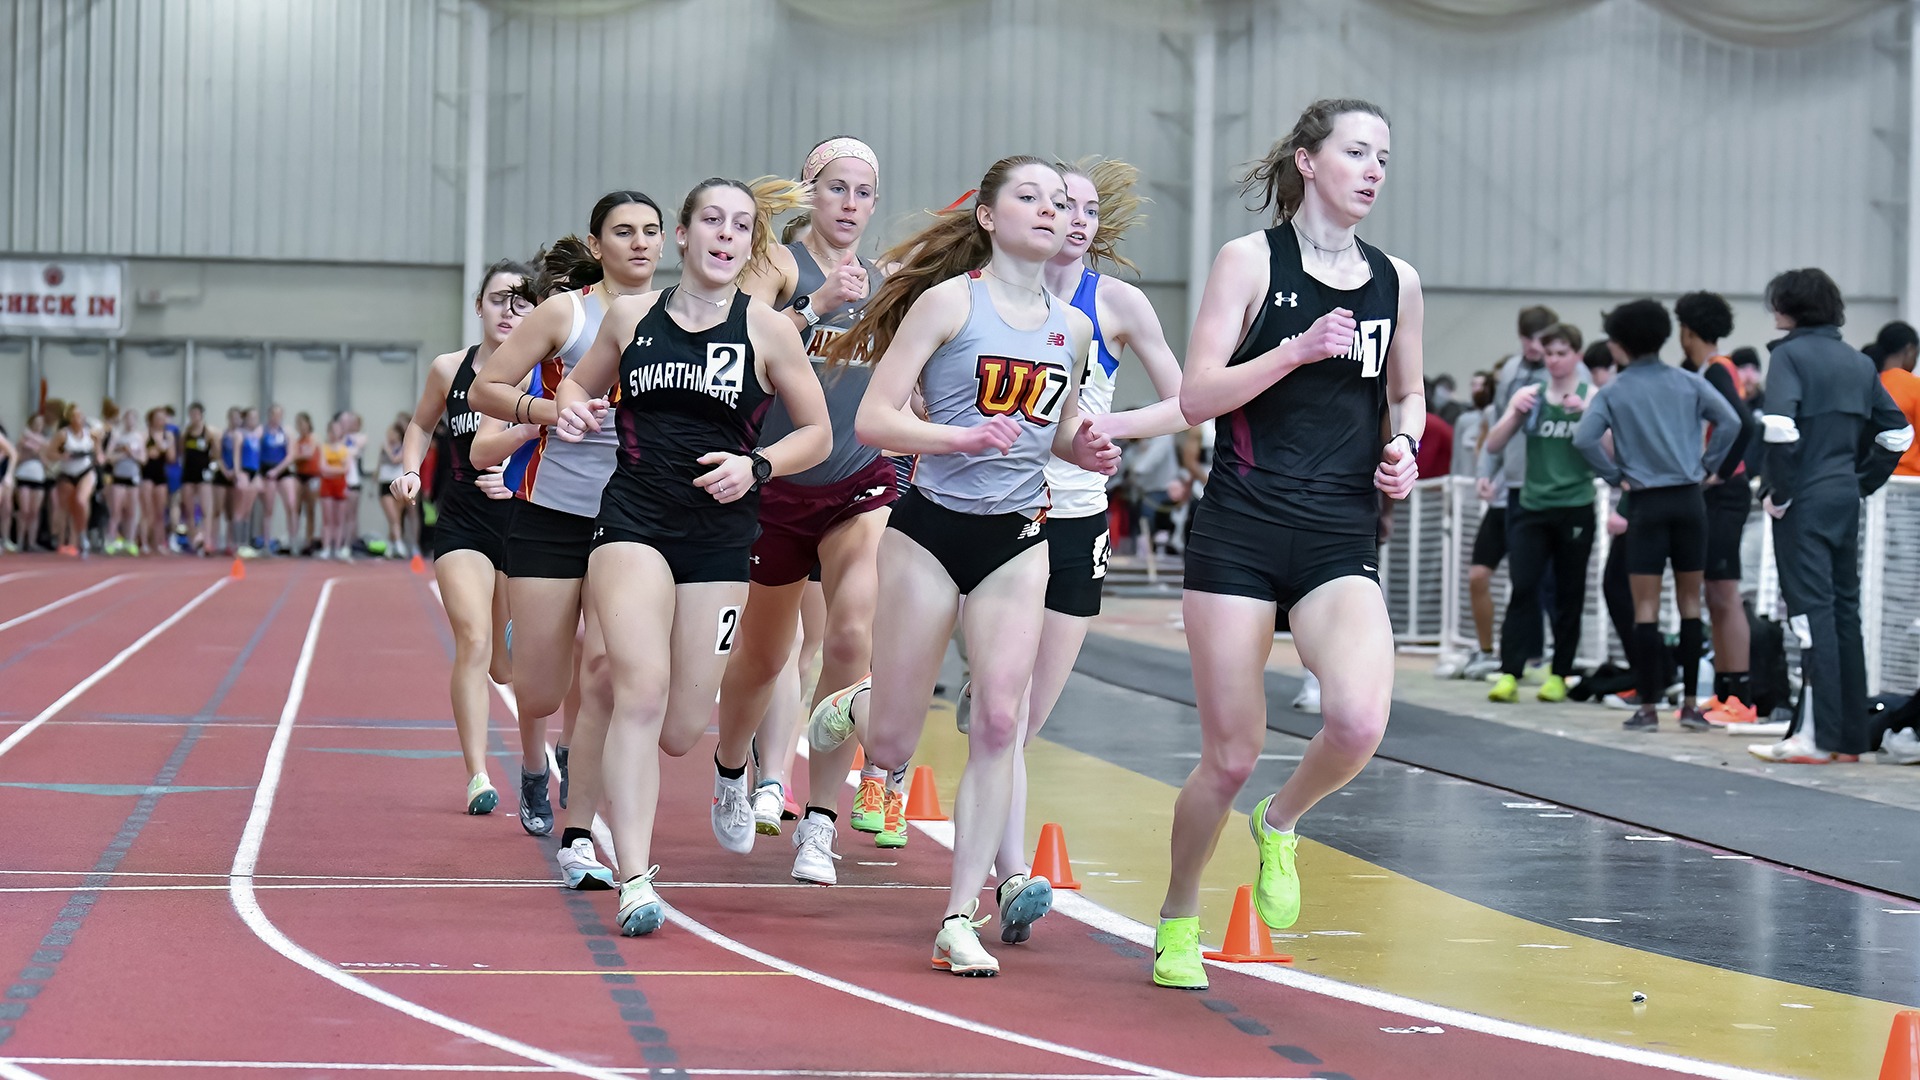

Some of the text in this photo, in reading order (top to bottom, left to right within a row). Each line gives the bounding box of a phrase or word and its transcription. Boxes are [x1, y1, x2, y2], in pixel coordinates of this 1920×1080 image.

[0, 294, 115, 317] HECK IN
[712, 346, 738, 388] 2
[1368, 324, 1382, 373] 1
[1040, 372, 1068, 416] 7
[718, 609, 737, 651] 2
